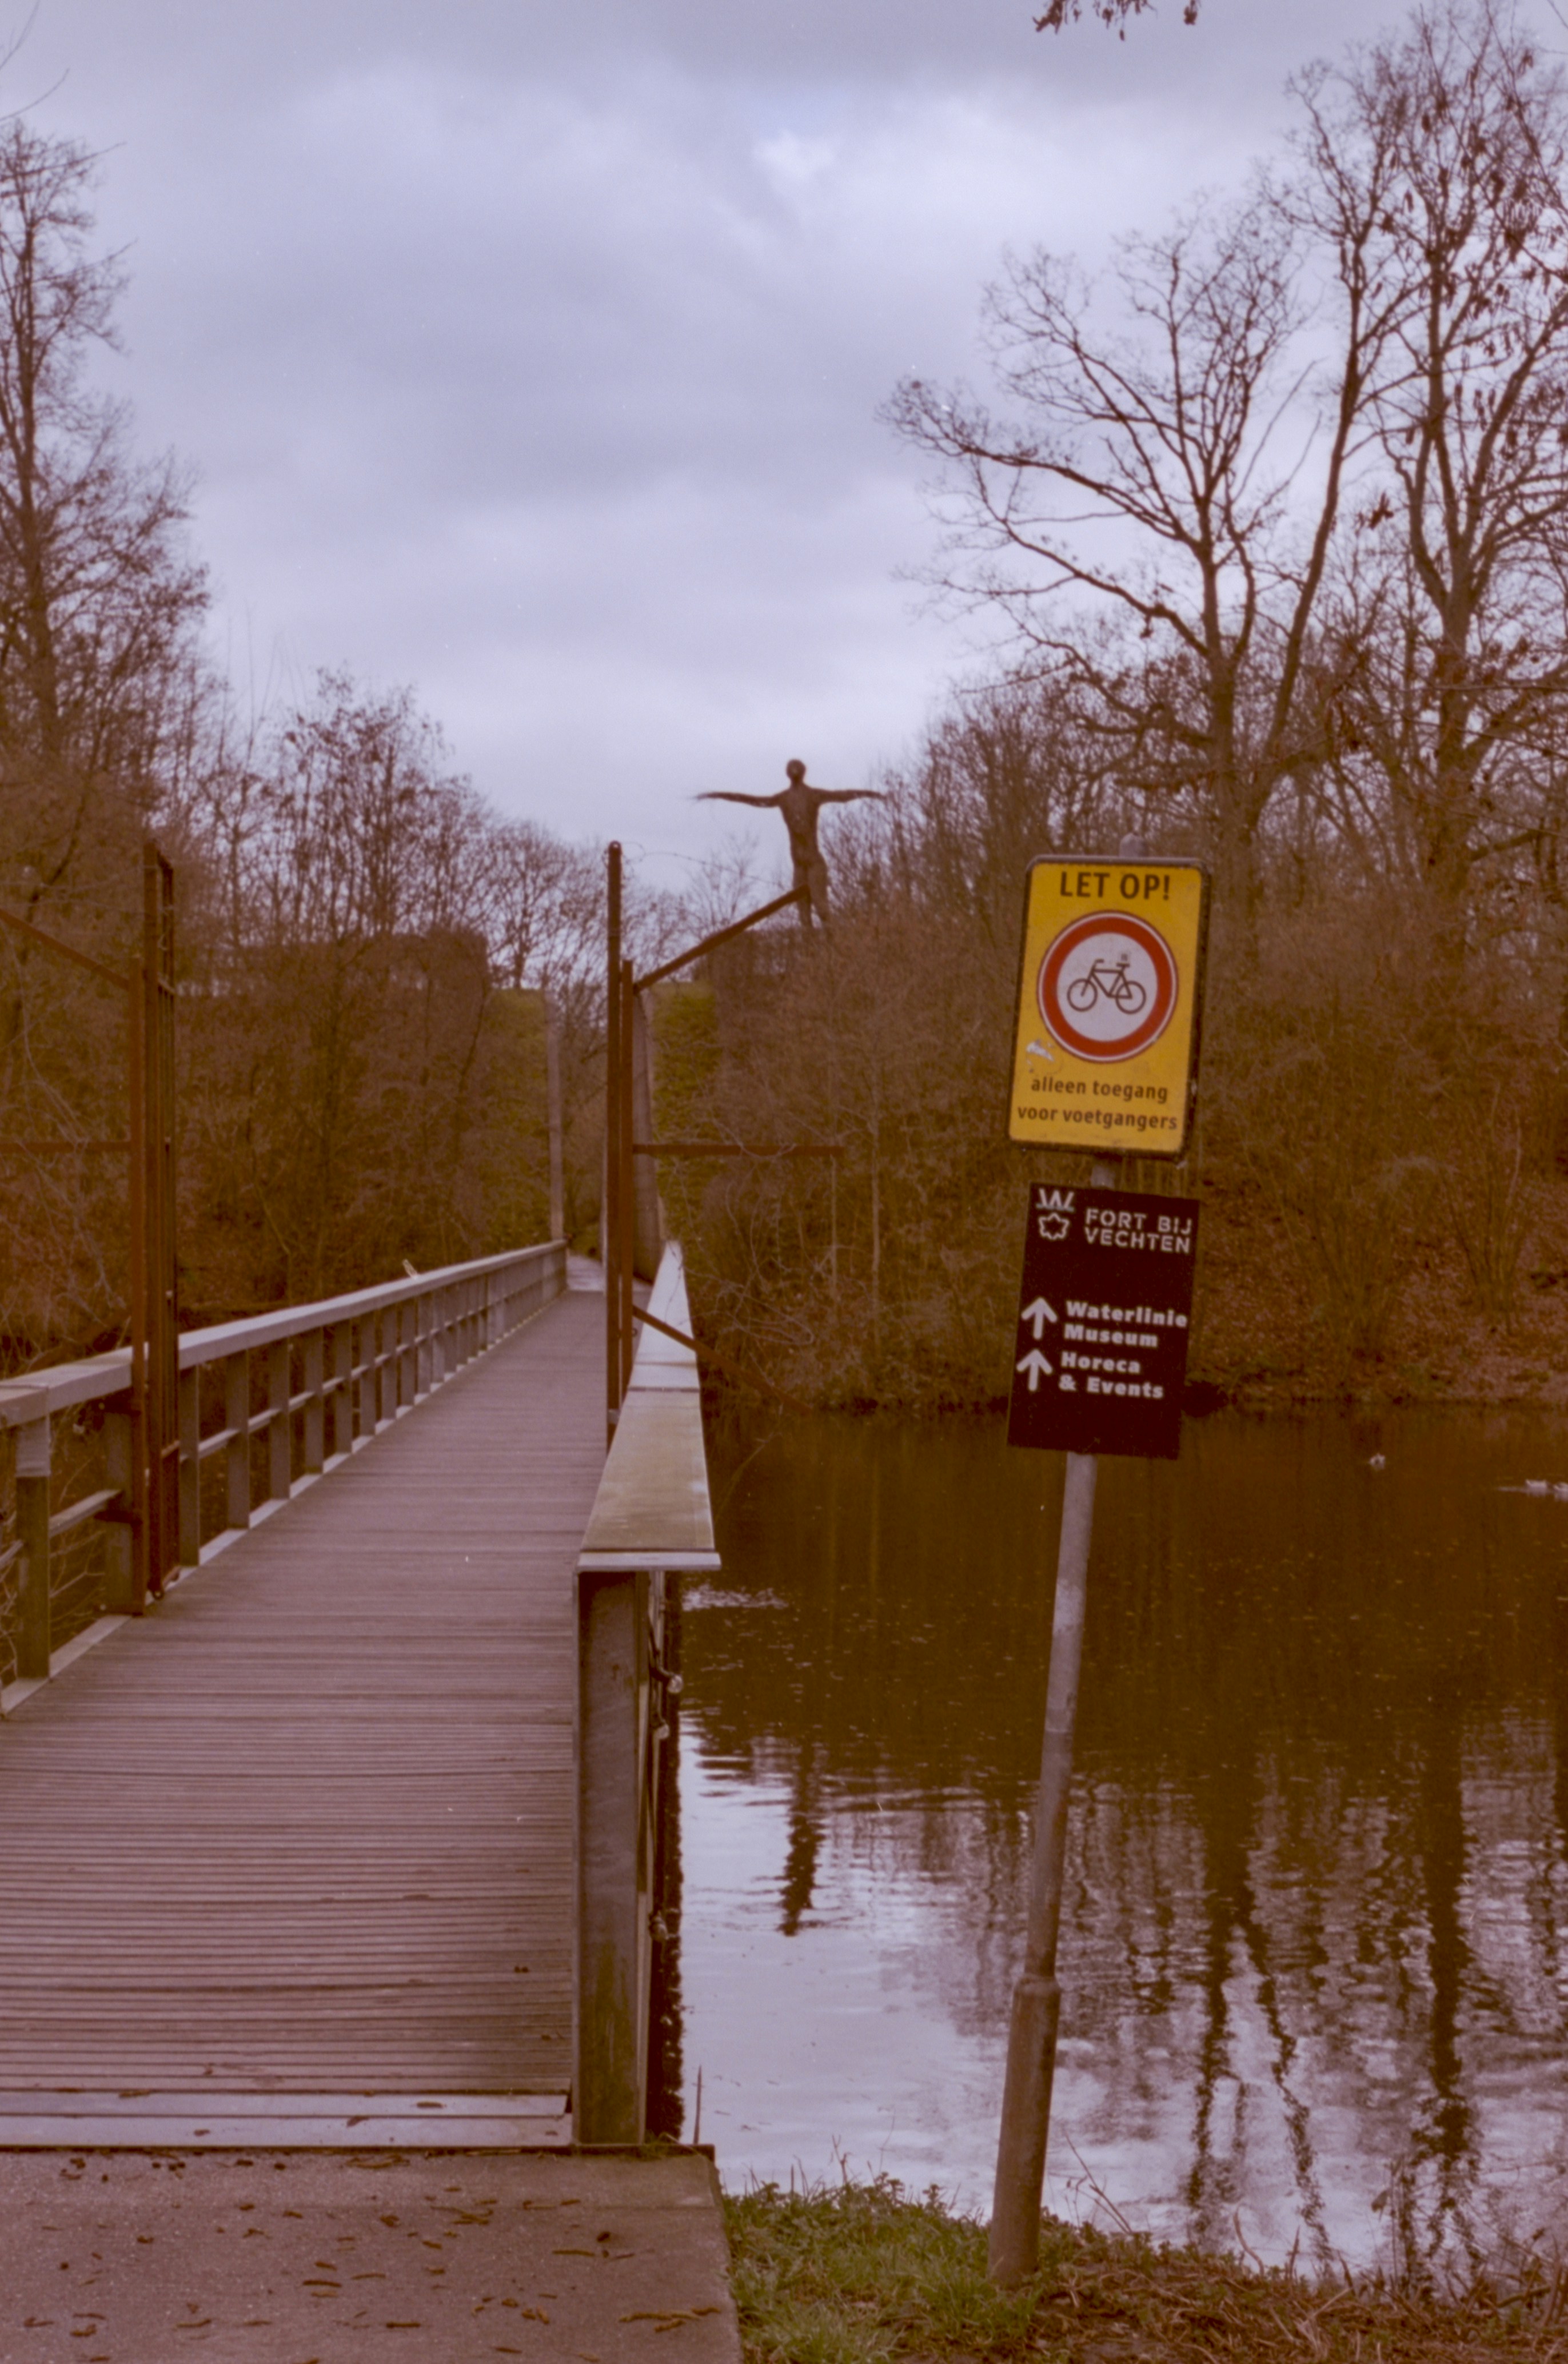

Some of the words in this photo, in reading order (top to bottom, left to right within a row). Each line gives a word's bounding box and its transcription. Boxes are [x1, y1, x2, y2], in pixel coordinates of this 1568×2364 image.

[1060, 871, 1110, 898] LET
[1119, 874, 1170, 900] OP!
[1031, 1077, 1086, 1094] alleen
[1092, 1080, 1168, 1104] toegang
[1018, 1106, 1058, 1121] voor
[1062, 1109, 1178, 1131] voetgangers
[1086, 1208, 1146, 1229] FORT
[1158, 1216, 1192, 1234] BIJ
[1085, 1226, 1191, 1254] VECHTEN
[1066, 1300, 1187, 1327] Waterlinie
[1064, 1323, 1158, 1348] Museum
[1061, 1351, 1141, 1374] Horeca
[1059, 1374, 1077, 1391] &
[1087, 1376, 1164, 1399] Events
